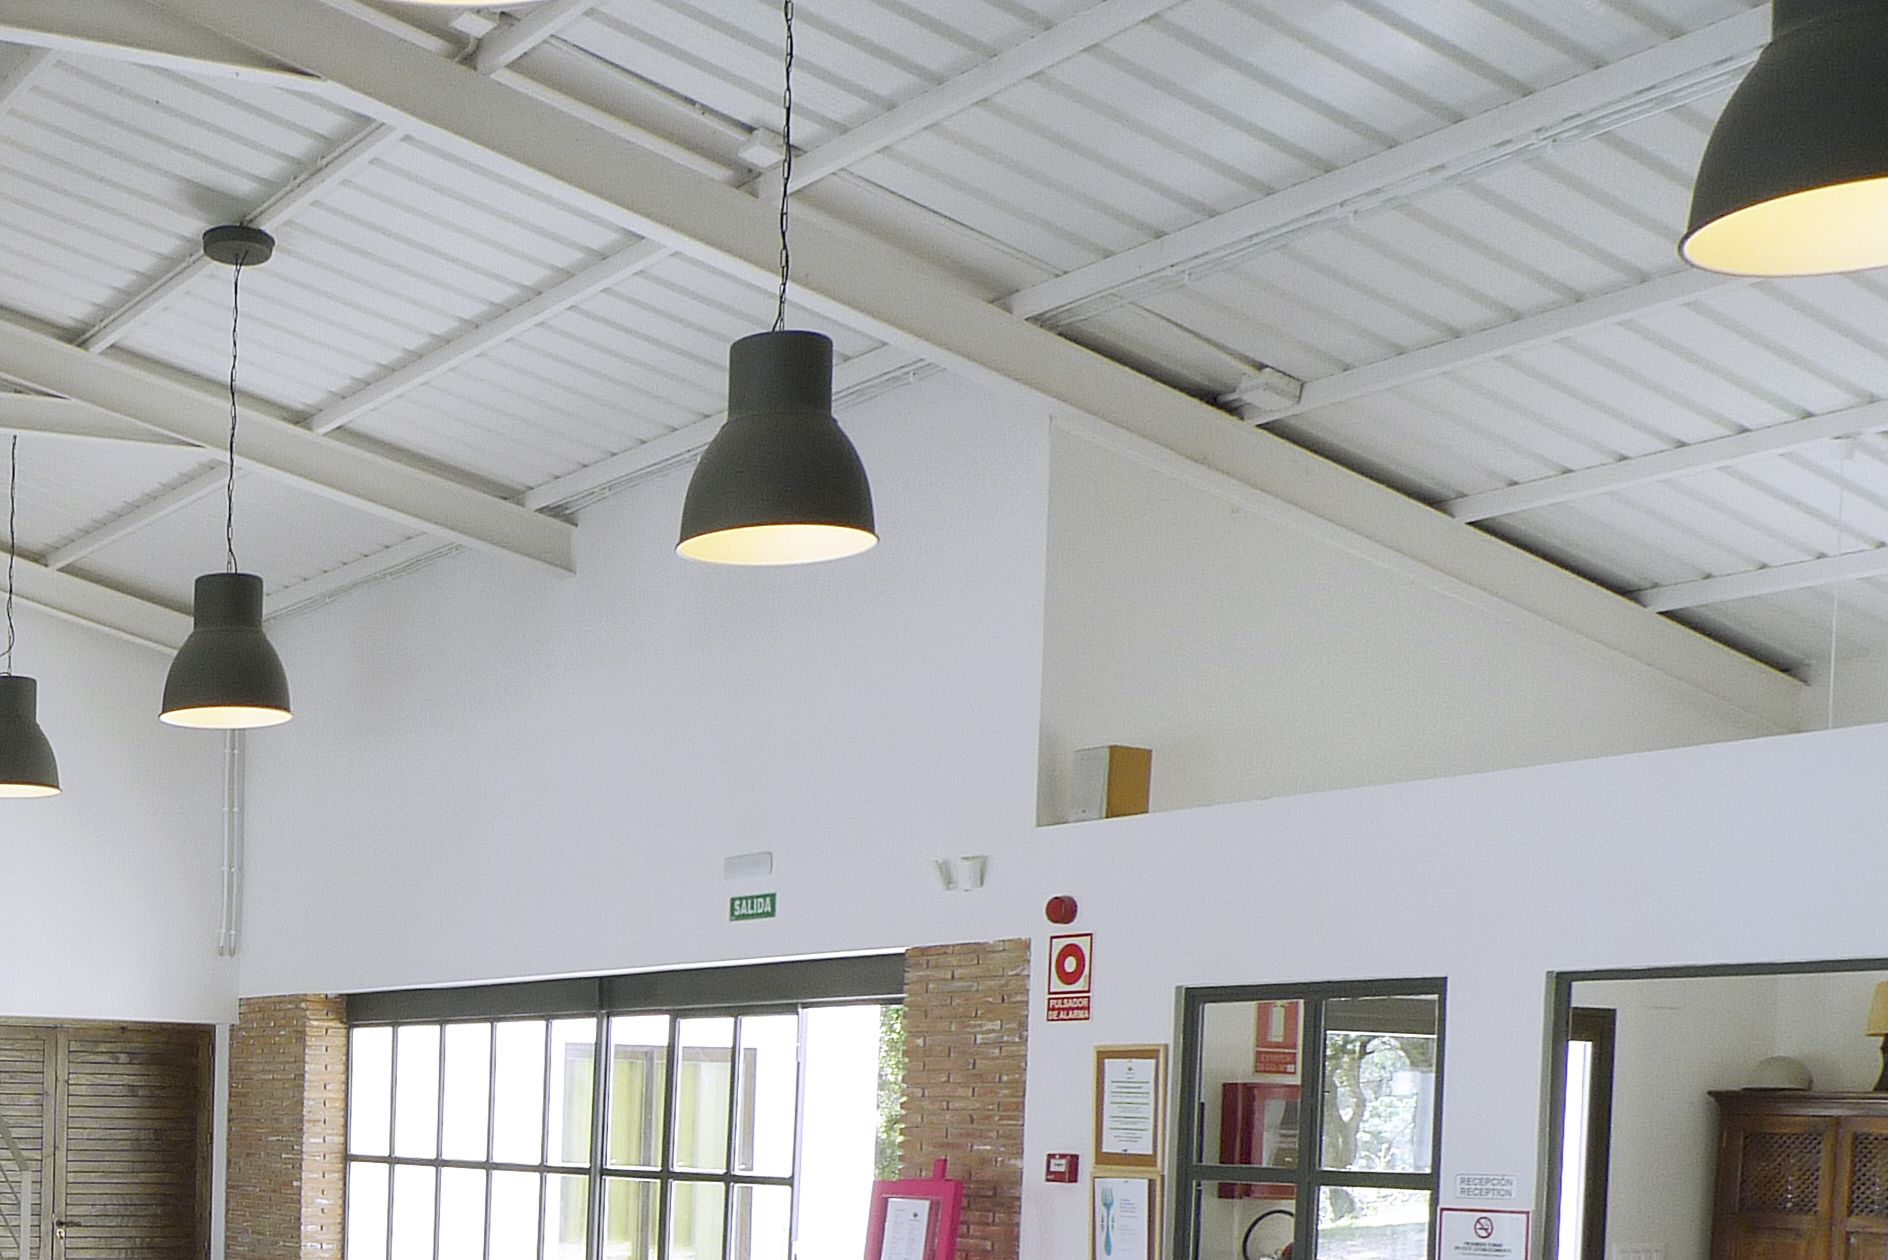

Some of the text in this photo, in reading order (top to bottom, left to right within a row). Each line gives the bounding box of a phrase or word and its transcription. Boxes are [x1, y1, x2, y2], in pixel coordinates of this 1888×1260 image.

[734, 896, 772, 916] SALIDA
[1049, 998, 1089, 1008] PULSADOR
[1048, 1009, 1089, 1020] DE ALARMA
[1459, 1187, 1513, 1197] RECEPTION
